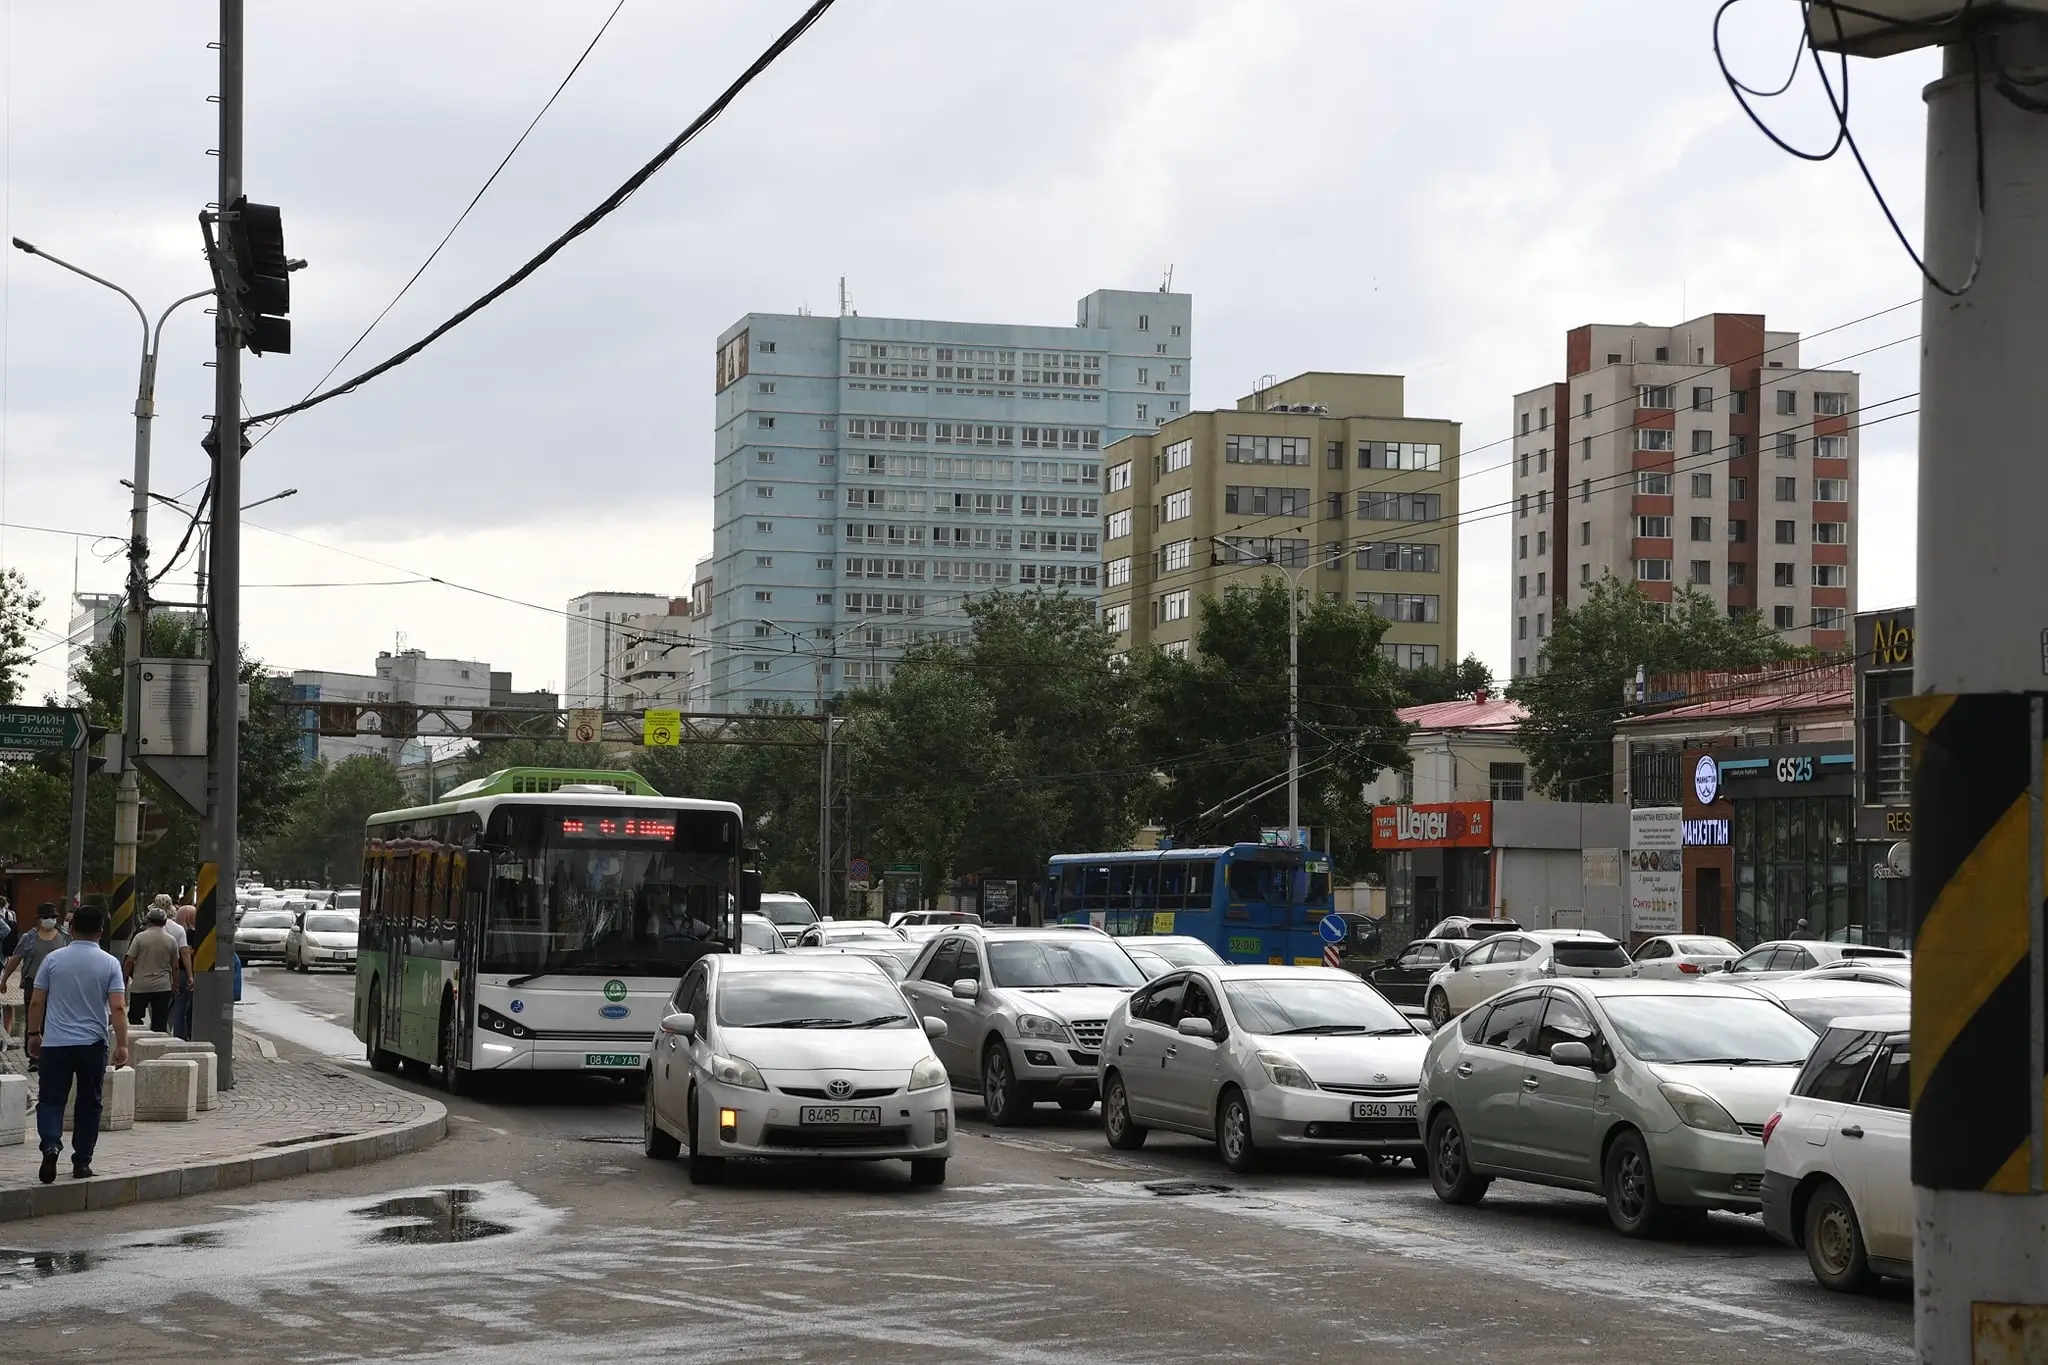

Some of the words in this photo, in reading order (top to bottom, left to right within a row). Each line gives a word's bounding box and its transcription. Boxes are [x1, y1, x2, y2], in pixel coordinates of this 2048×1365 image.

[0, 714, 65, 725] НГЭРИЙН
[21, 725, 65, 735] ГУДАМЖ
[4, 736, 22, 745] Blue
[23, 737, 38, 746] Sky
[39, 738, 64, 747] Street
[1776, 756, 1812, 783] GS25
[807, 1108, 840, 1122] 8485
[1359, 1103, 1388, 1117] 6349
